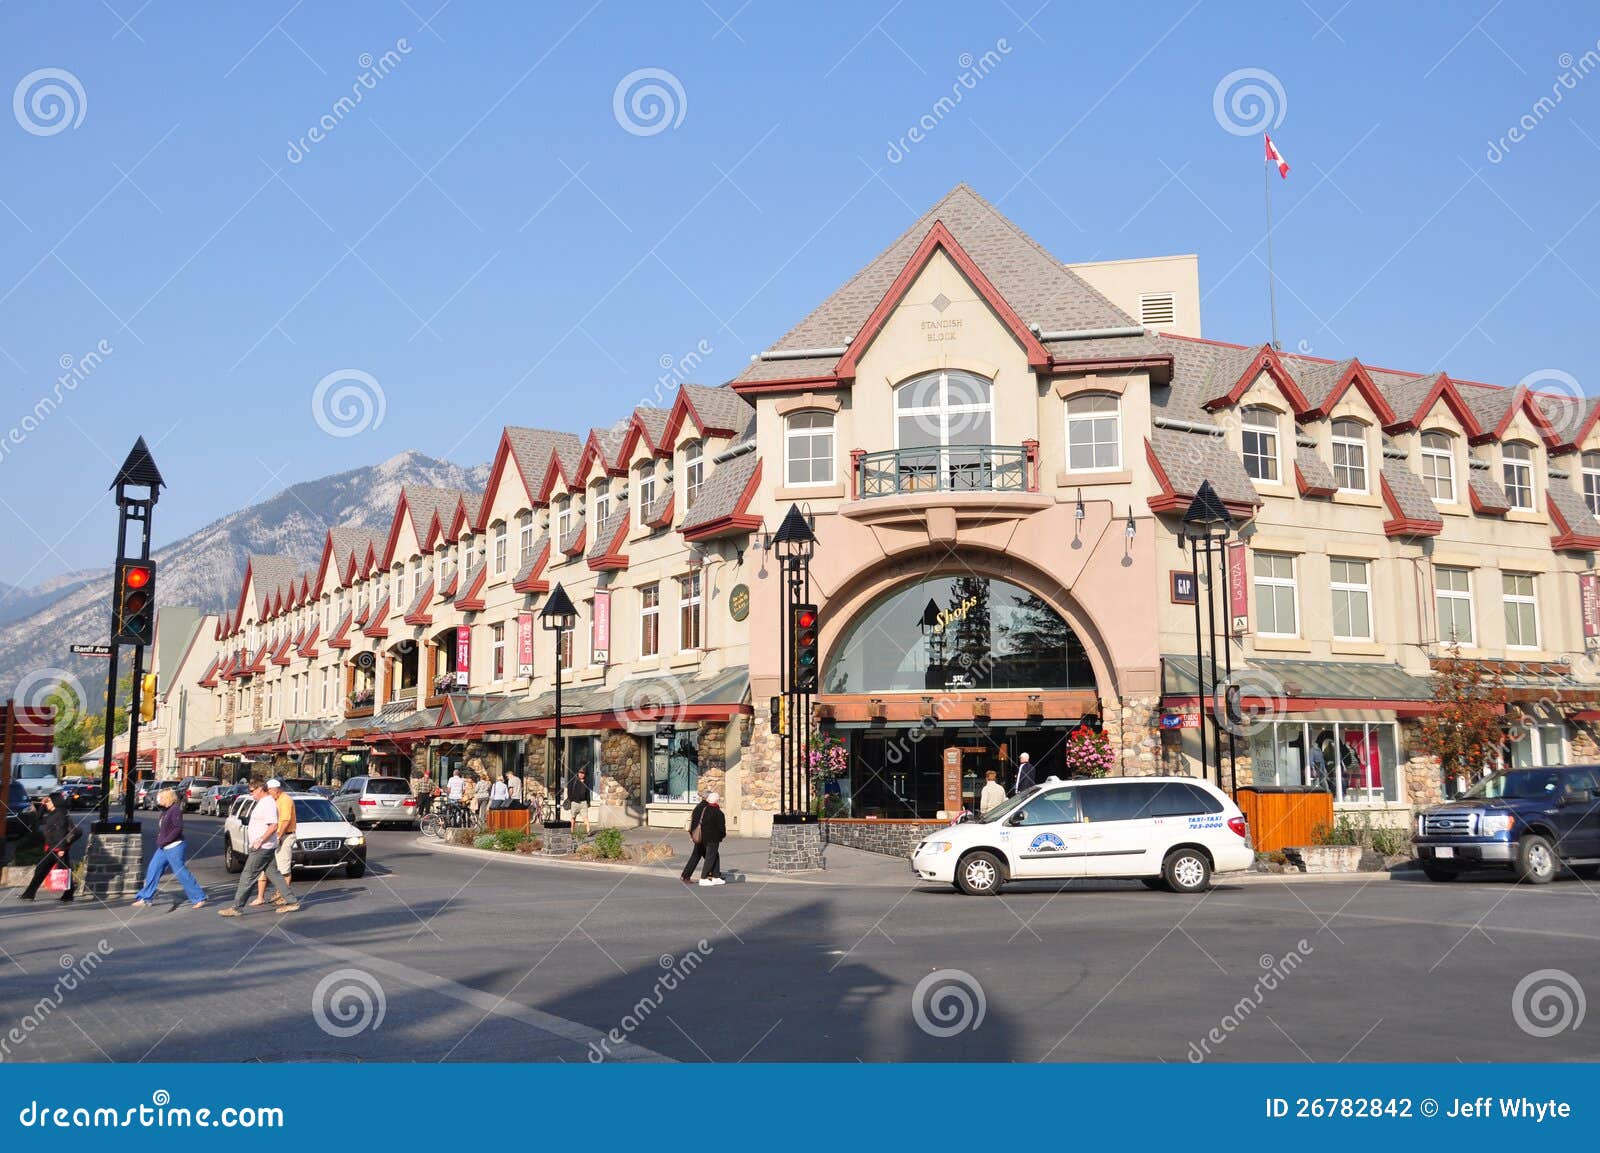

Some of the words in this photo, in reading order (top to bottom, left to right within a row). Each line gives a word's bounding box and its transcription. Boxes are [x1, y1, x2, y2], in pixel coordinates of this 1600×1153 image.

[920, 319, 963, 330] STANDISH
[927, 332, 957, 342] BLOCK
[1177, 578, 1191, 595] GAP
[933, 596, 977, 635] Shops
[73, 645, 94, 653] Banff
